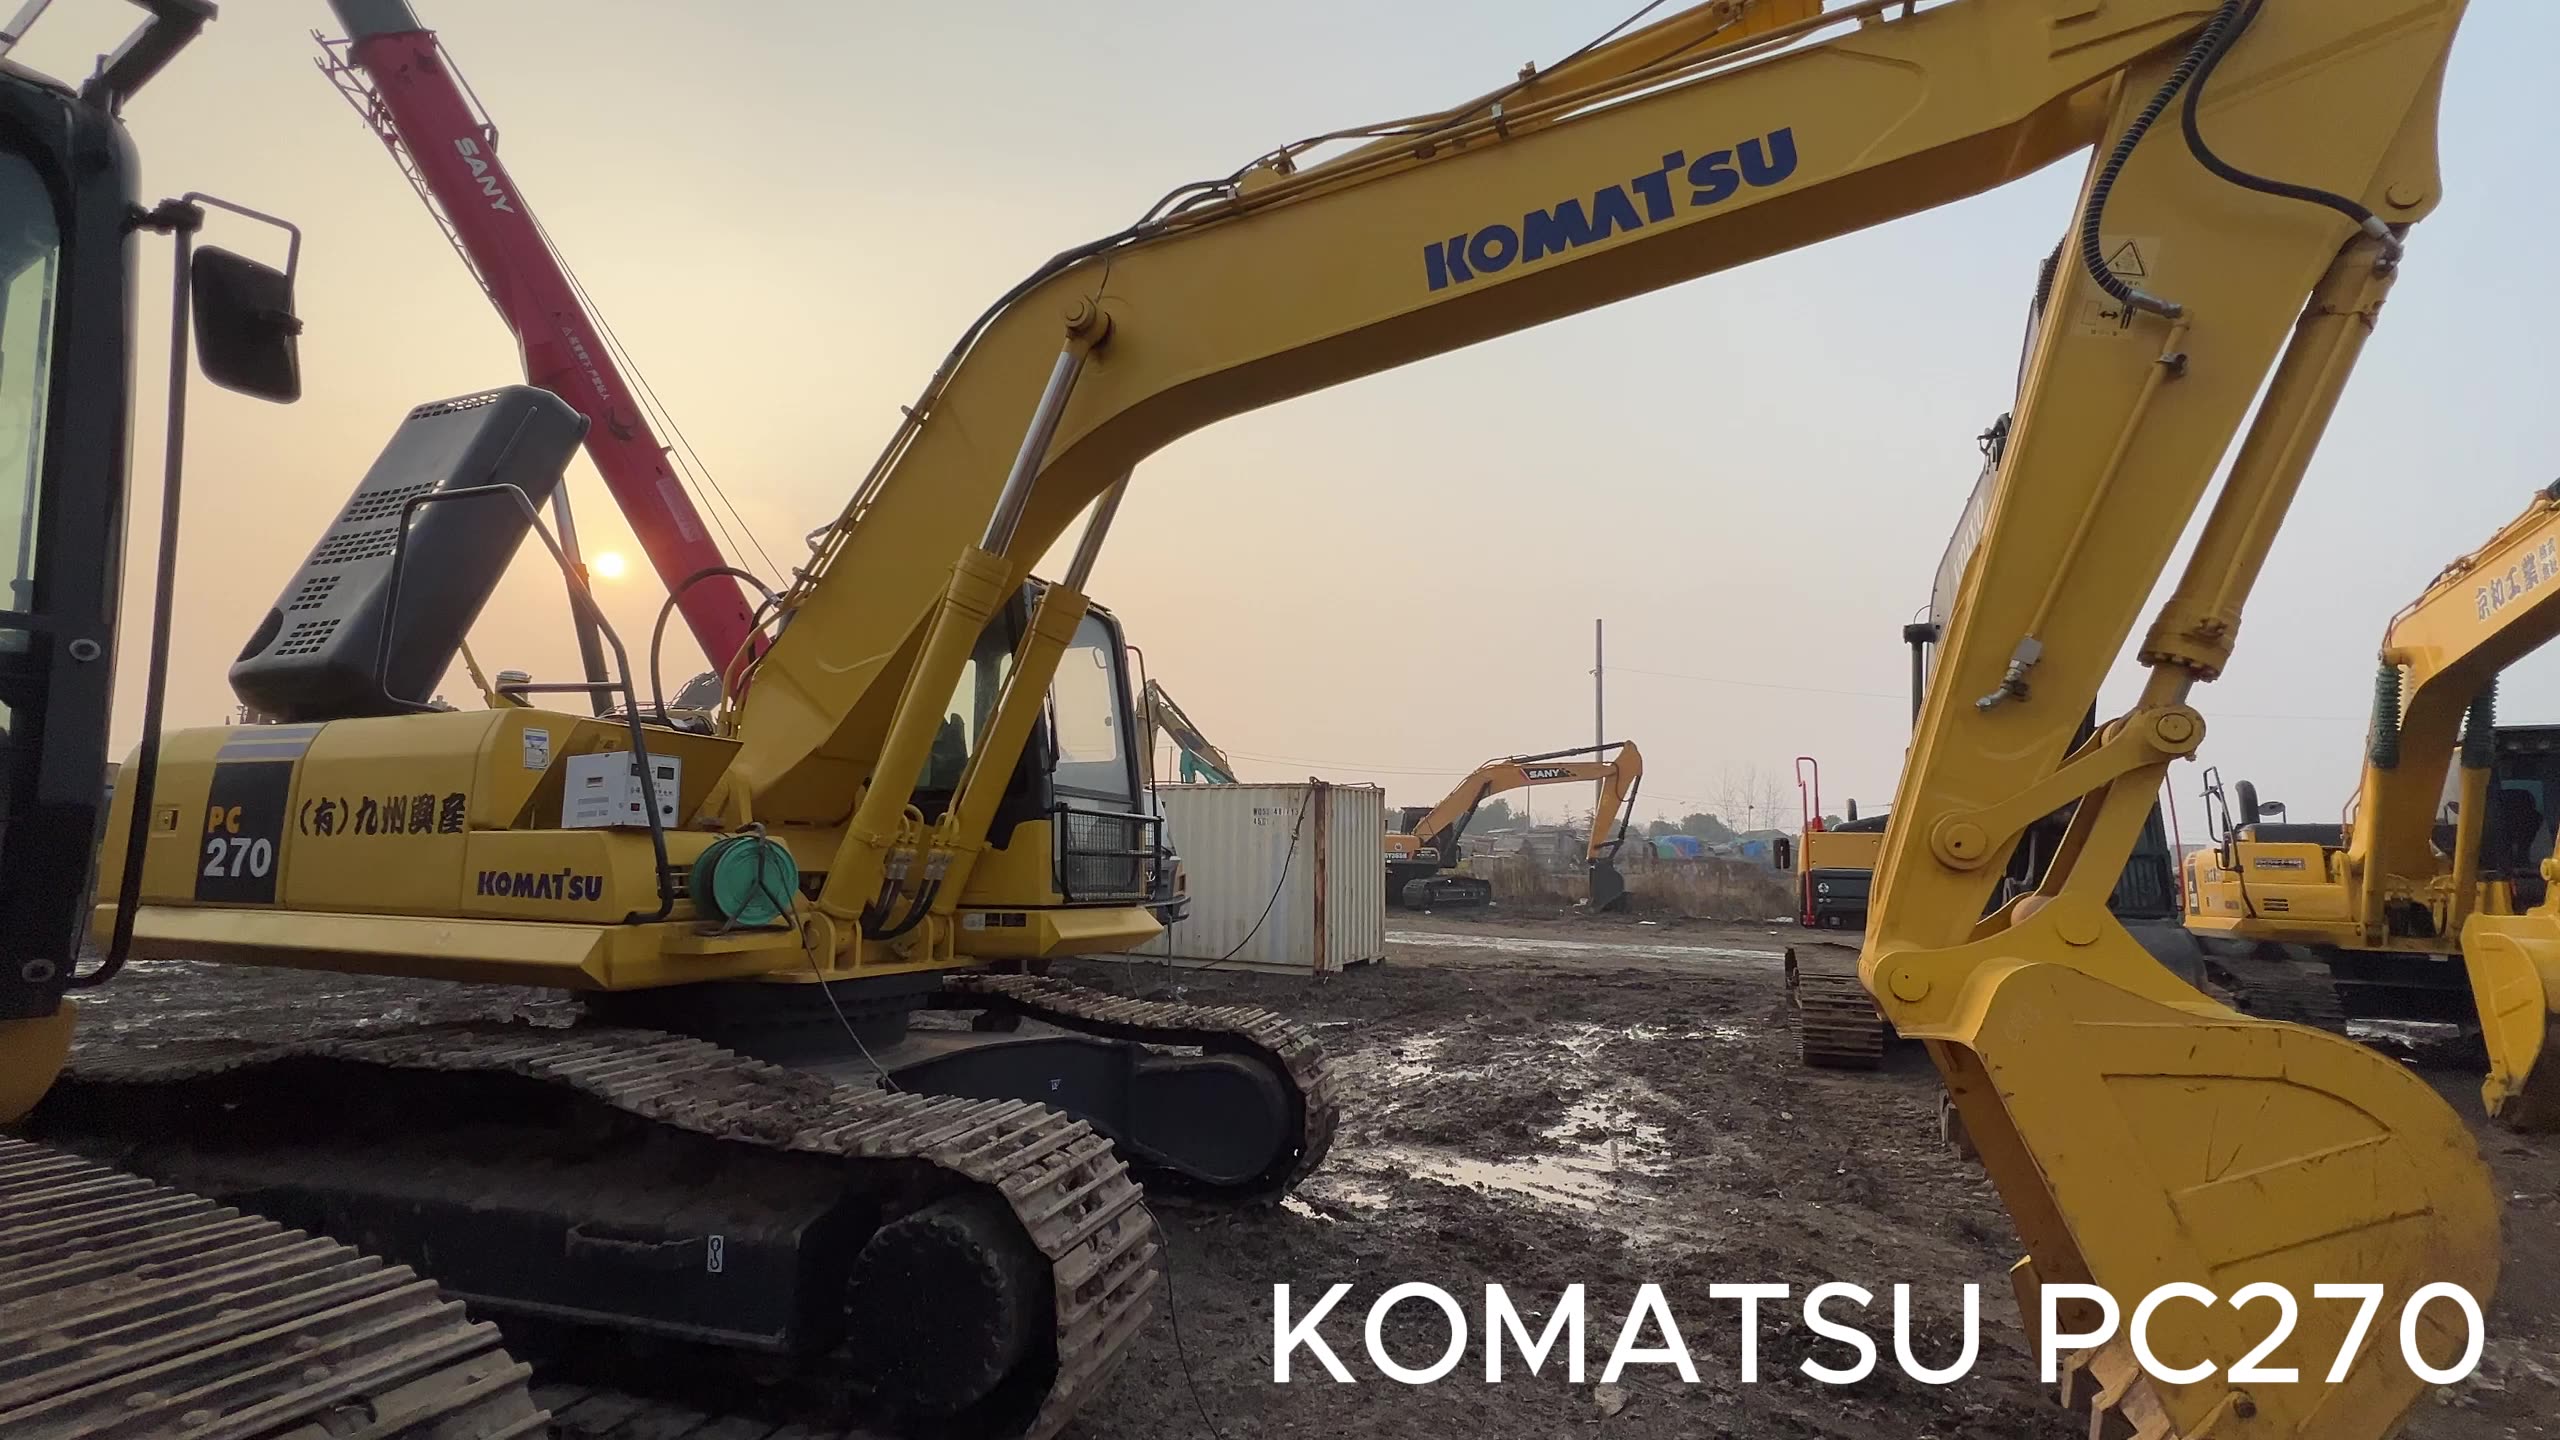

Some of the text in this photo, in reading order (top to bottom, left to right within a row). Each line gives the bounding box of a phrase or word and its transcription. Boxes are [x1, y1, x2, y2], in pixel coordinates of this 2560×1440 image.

[455, 137, 514, 213] SANY
[1424, 127, 1798, 291] KOMATSU
[1529, 769, 1560, 779] SANY
[208, 806, 242, 833] PC
[203, 838, 272, 877] 270
[477, 868, 603, 901] KOMATSU
